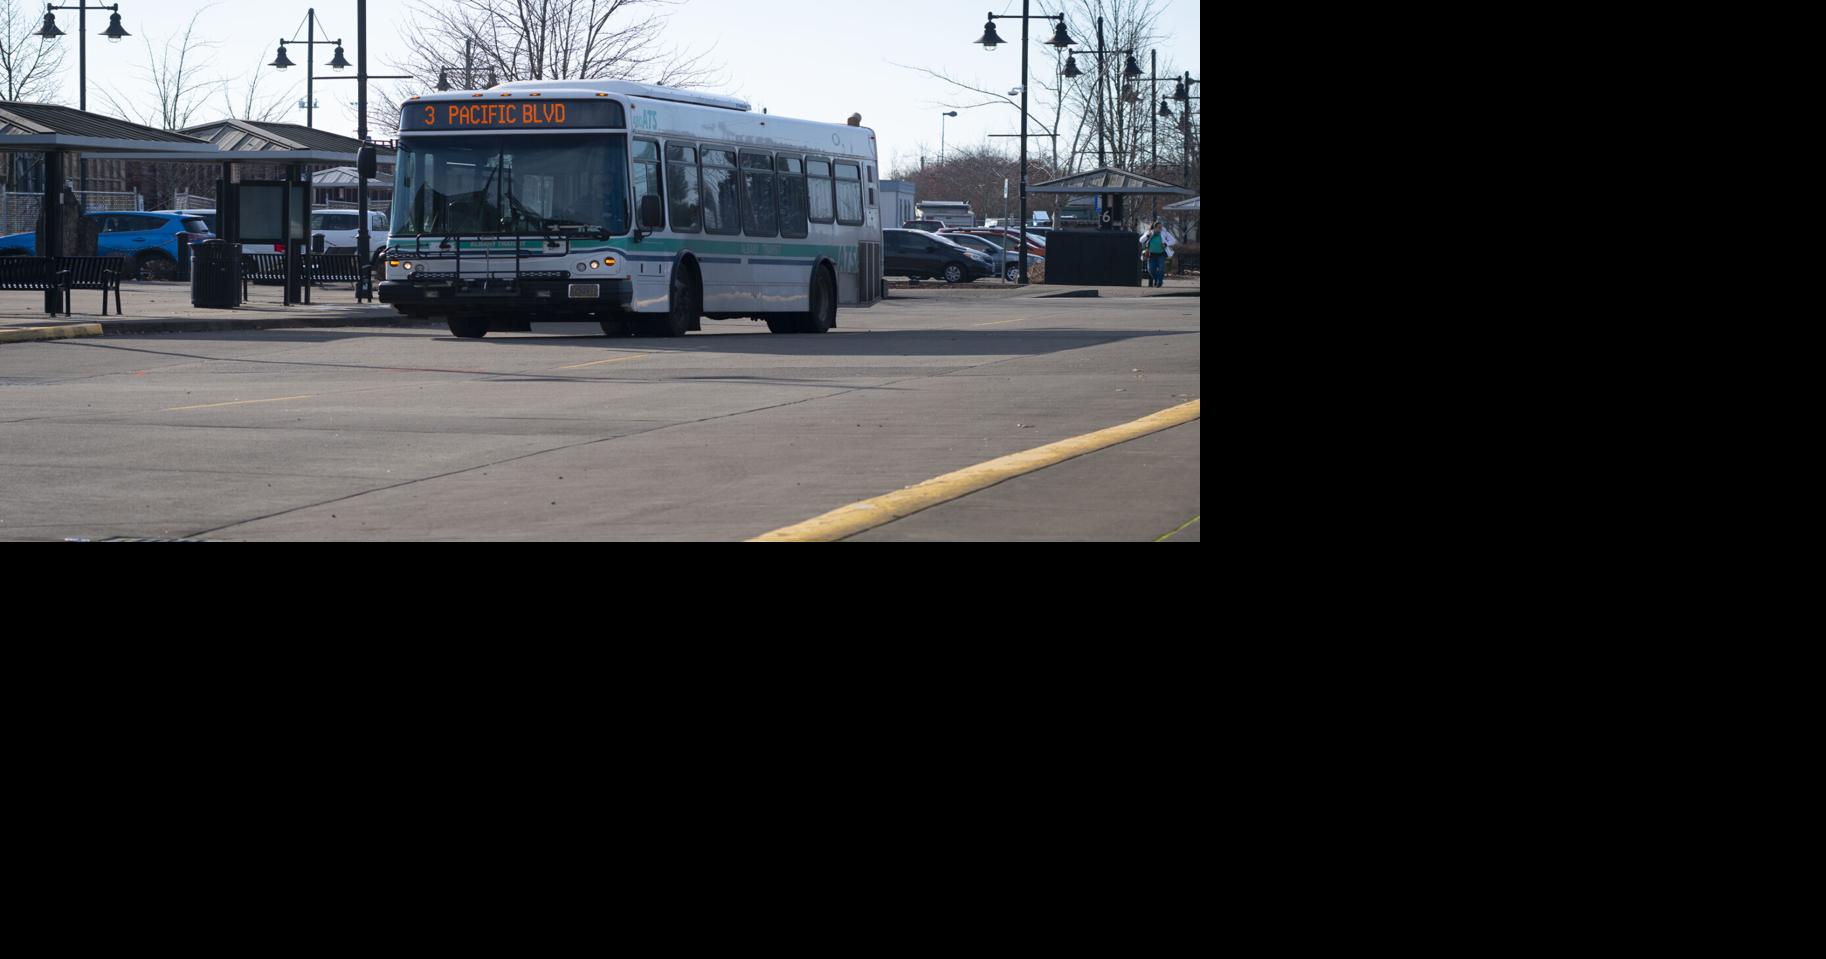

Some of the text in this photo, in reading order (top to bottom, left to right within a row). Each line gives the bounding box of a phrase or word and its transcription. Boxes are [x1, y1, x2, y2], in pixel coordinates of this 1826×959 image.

[424, 103, 566, 125] 3 PACIFIC BLVD
[1102, 210, 1110, 222] 6
